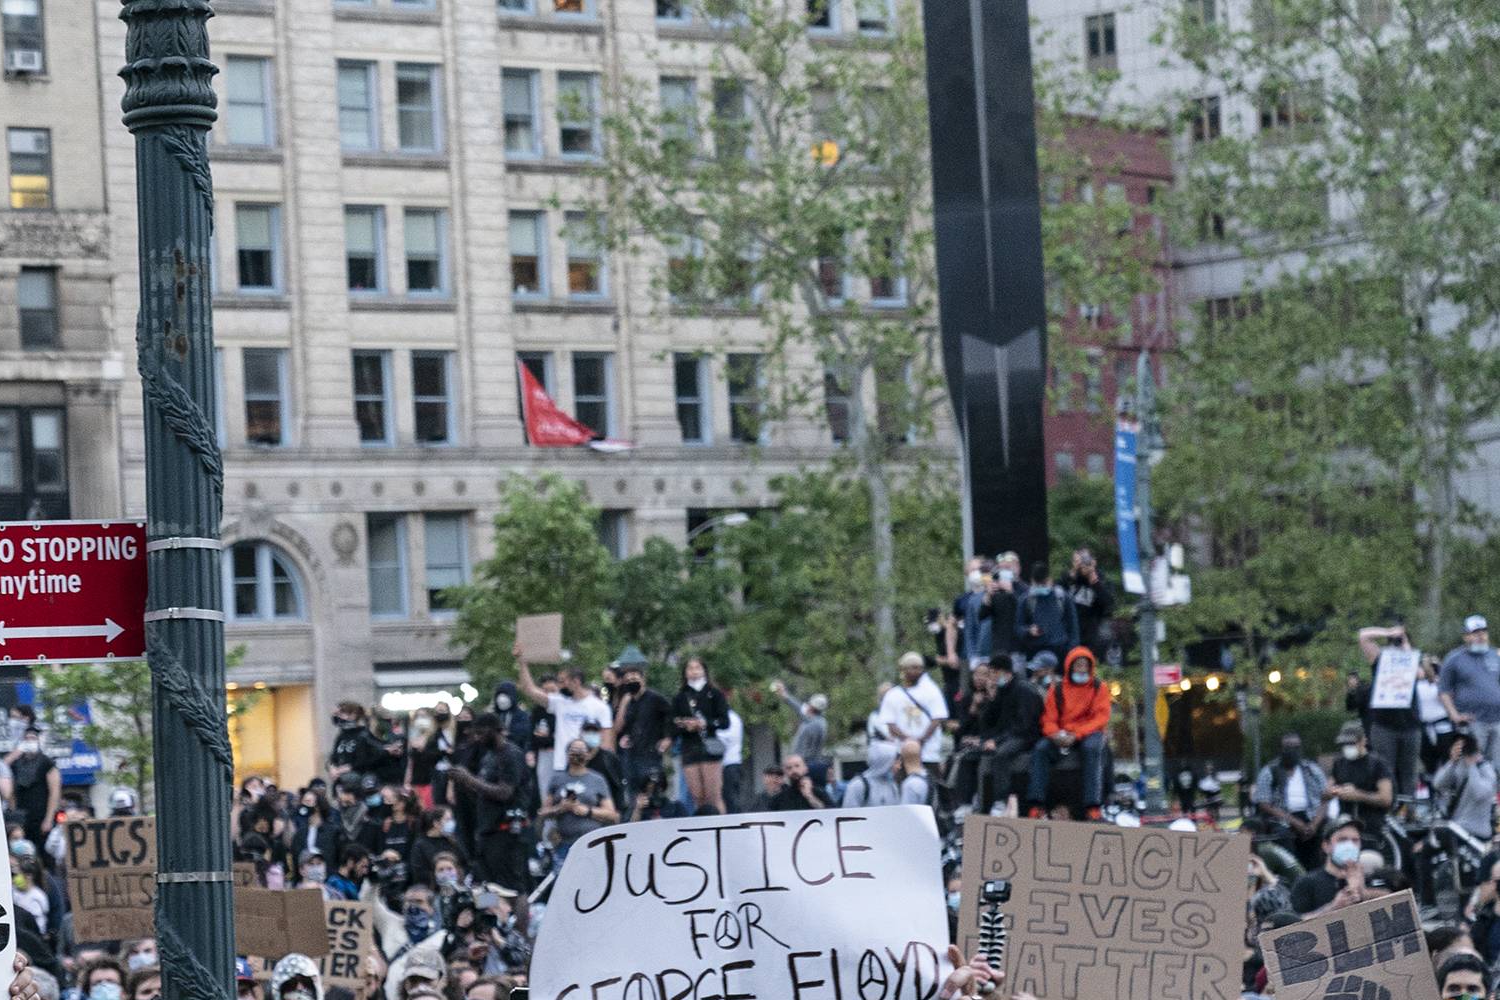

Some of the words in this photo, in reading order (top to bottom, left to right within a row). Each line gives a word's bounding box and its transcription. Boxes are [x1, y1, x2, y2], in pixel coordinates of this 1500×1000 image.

[21, 535, 138, 562] STOPPING
[574, 816, 876, 914] JUSTICE
[981, 822, 1229, 893] BLACK
[683, 902, 791, 959] FOR
[1273, 900, 1421, 987] BLM
